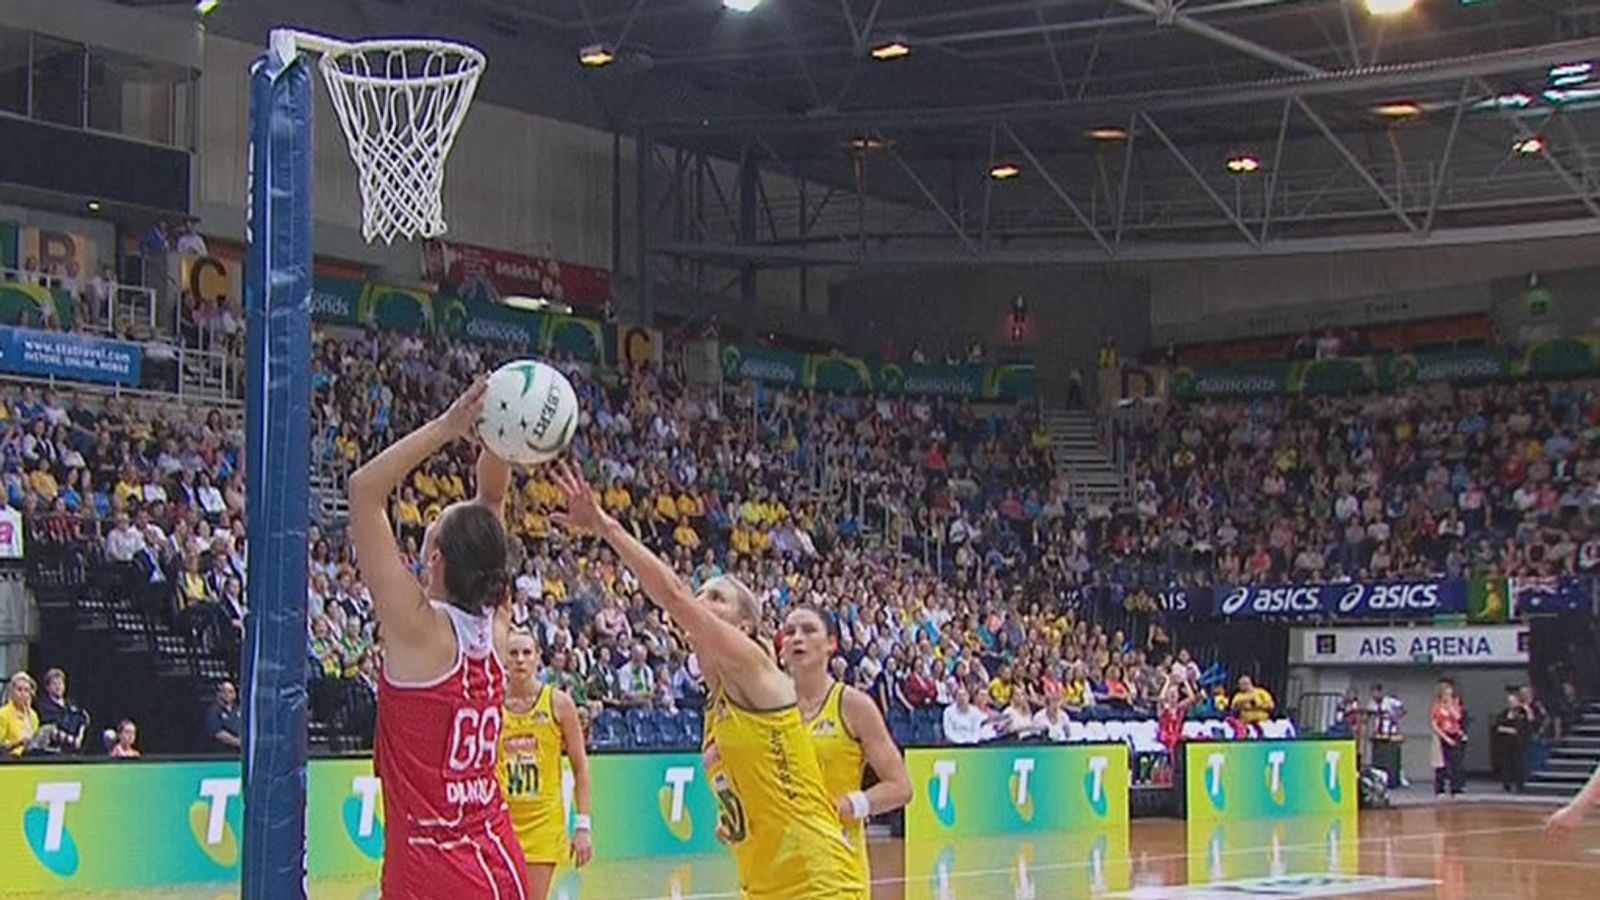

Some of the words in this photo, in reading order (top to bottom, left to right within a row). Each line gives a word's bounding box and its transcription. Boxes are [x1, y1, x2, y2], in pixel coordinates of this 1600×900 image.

[1360, 636, 1397, 656] AIS
[1409, 636, 1492, 656] ARENA
[449, 706, 501, 770] GA
